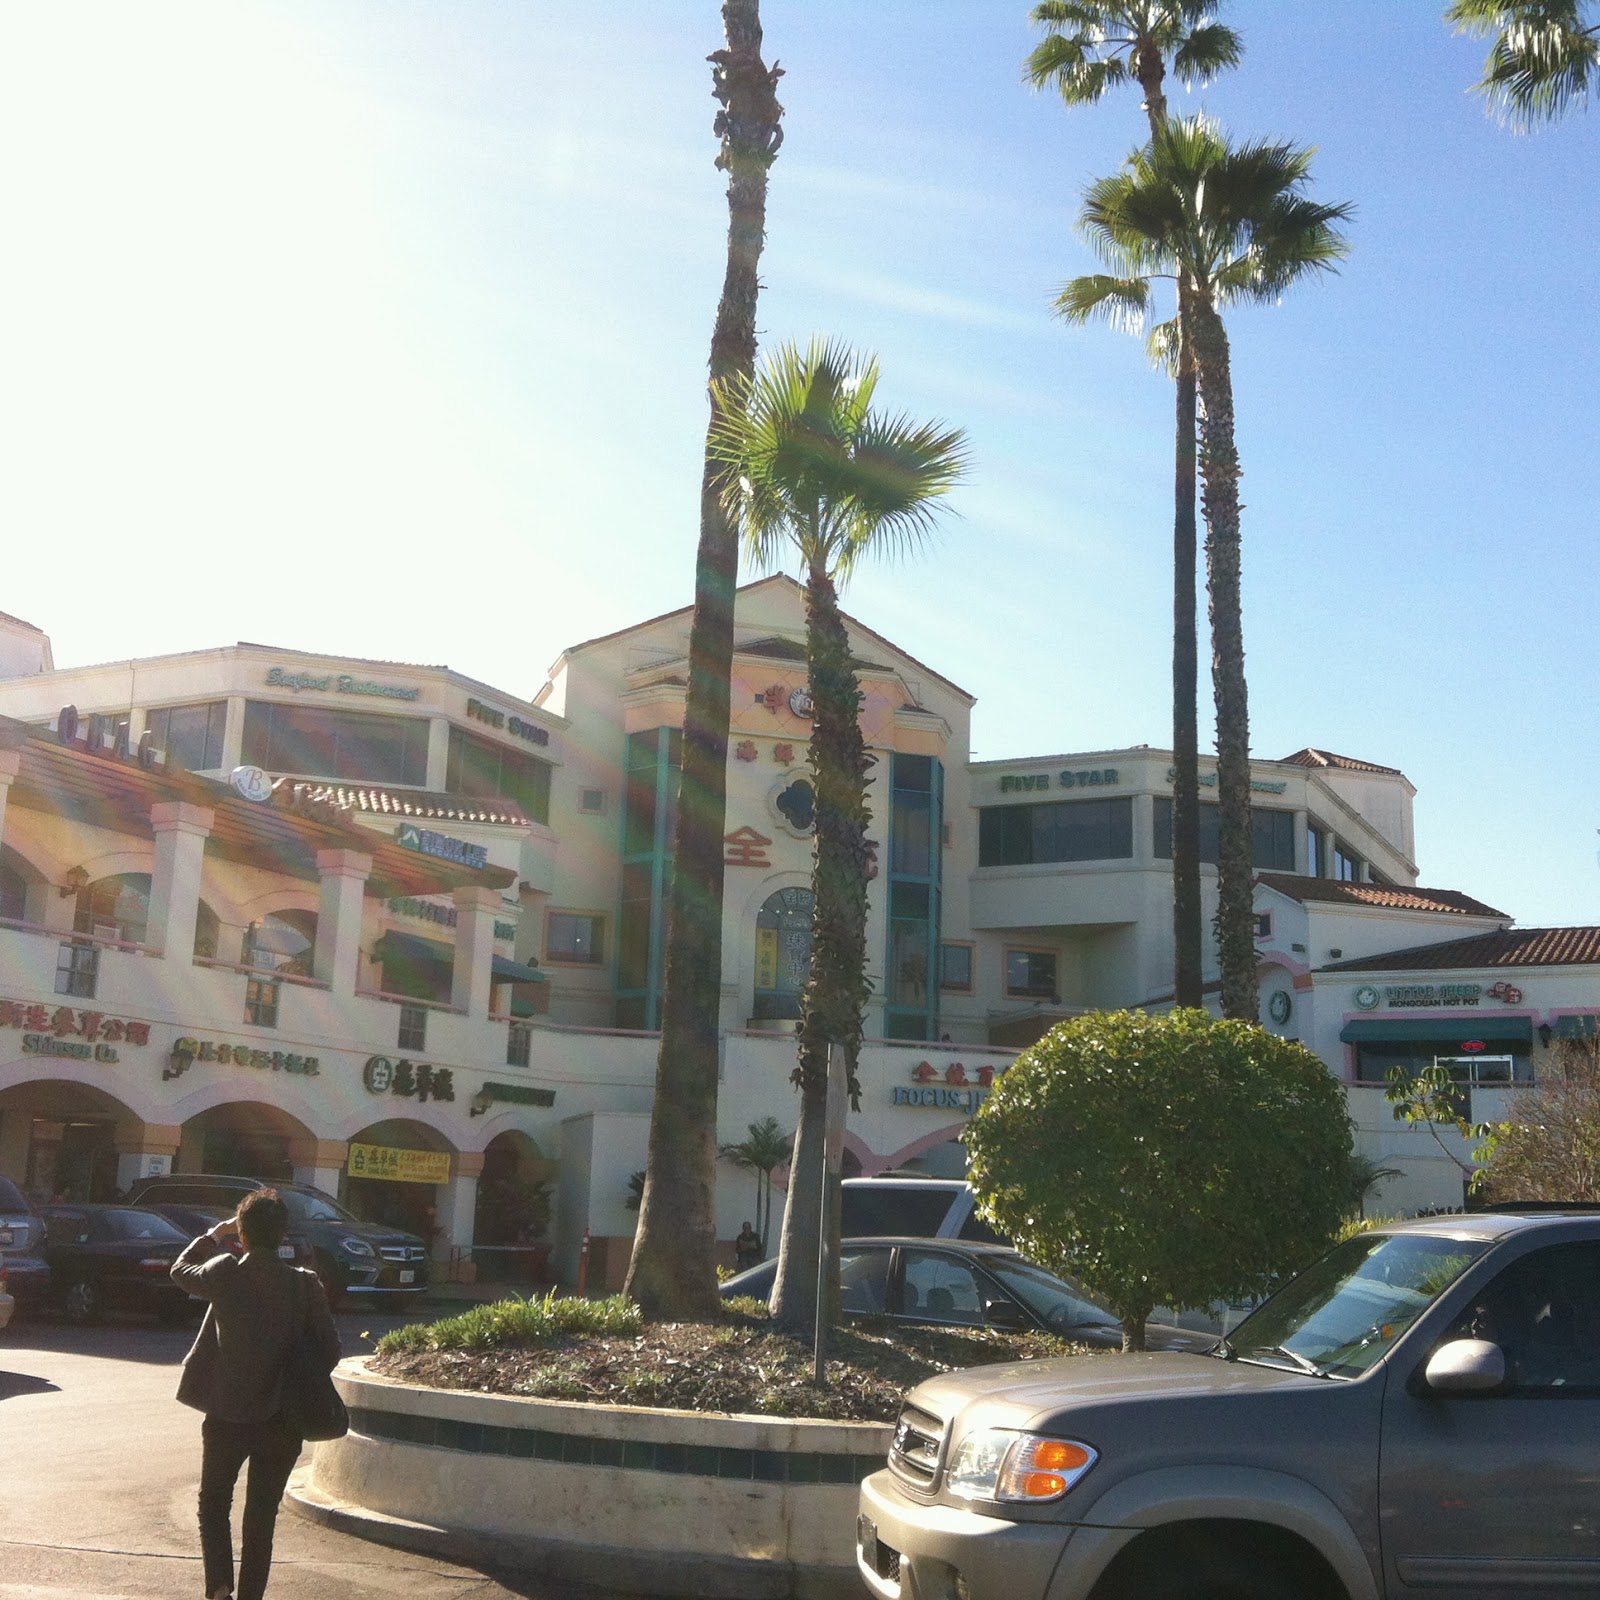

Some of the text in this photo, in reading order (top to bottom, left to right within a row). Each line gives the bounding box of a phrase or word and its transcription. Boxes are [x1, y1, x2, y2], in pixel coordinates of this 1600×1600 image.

[265, 667, 420, 701] Seafood Restaurant
[467, 698, 549, 746] FIVE STAR
[1001, 768, 1119, 793] FIVE STAR
[1386, 984, 1482, 999] LITTLE SHEEP
[1388, 998, 1480, 1008] MONGOLIAN HOT POT
[893, 1087, 961, 1109] FOCUS
